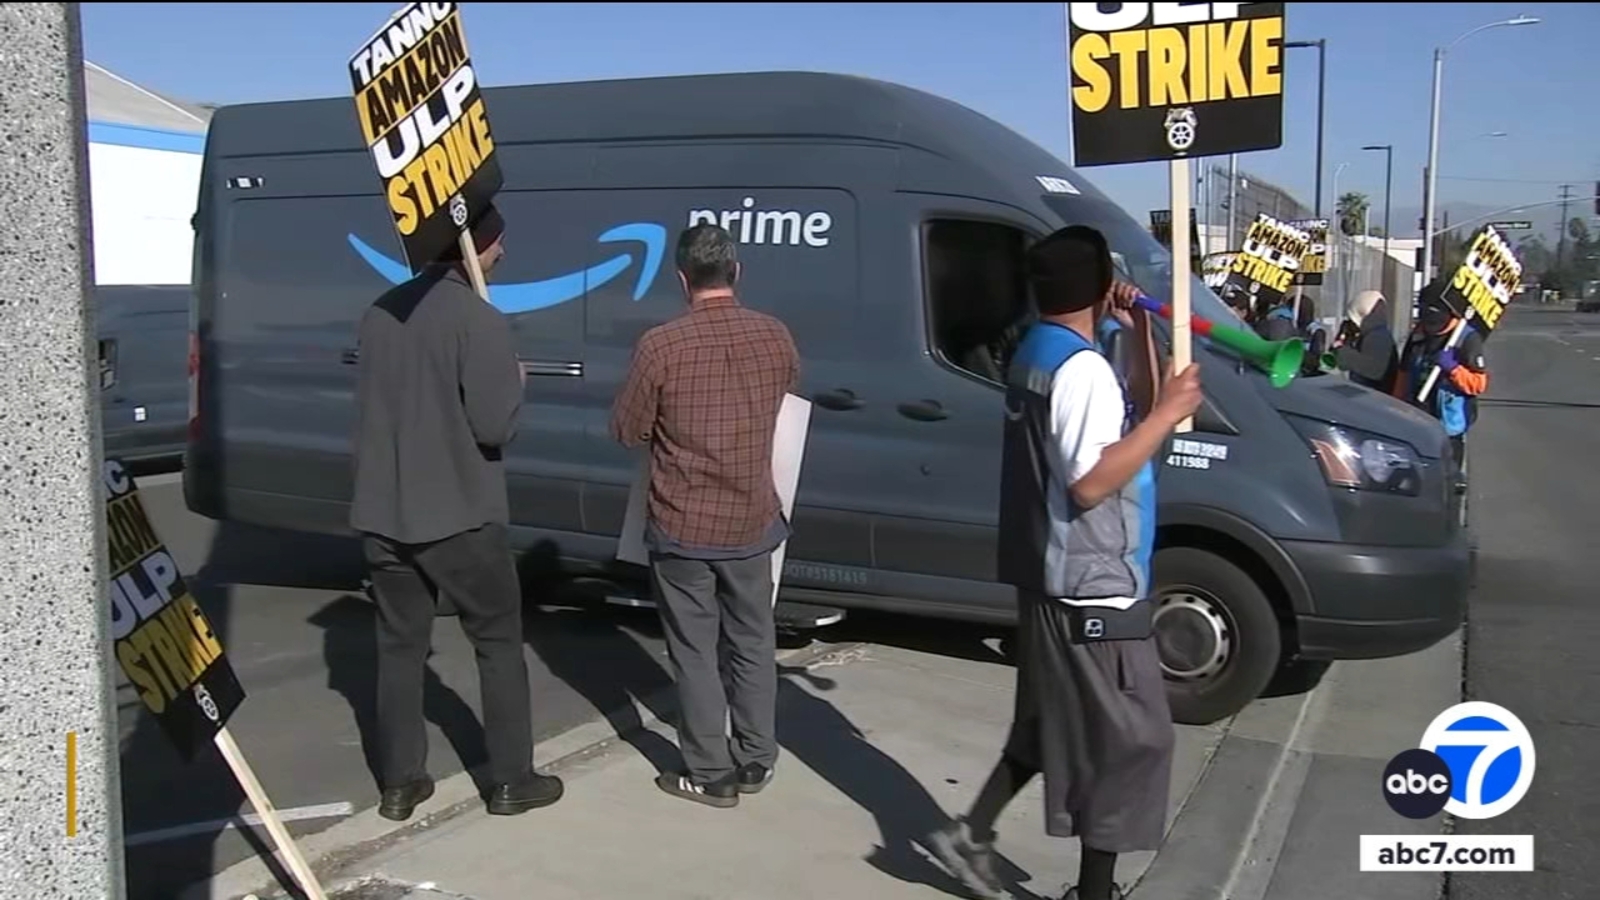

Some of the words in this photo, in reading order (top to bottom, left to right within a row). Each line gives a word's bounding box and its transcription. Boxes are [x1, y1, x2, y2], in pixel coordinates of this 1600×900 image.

[365, 16, 466, 139] AMAZON
[1071, 16, 1283, 113] STRIKE
[373, 65, 475, 178] ULP
[387, 99, 495, 236] STRIKE
[1242, 239, 1300, 271] ULP
[1250, 225, 1305, 260] AMAZON
[1258, 213, 1310, 243] TANNC
[1233, 252, 1295, 293] STRIKE
[1453, 265, 1505, 330] STRIKE
[1476, 238, 1520, 293] AMAZON
[116, 591, 224, 714] STRIKE
